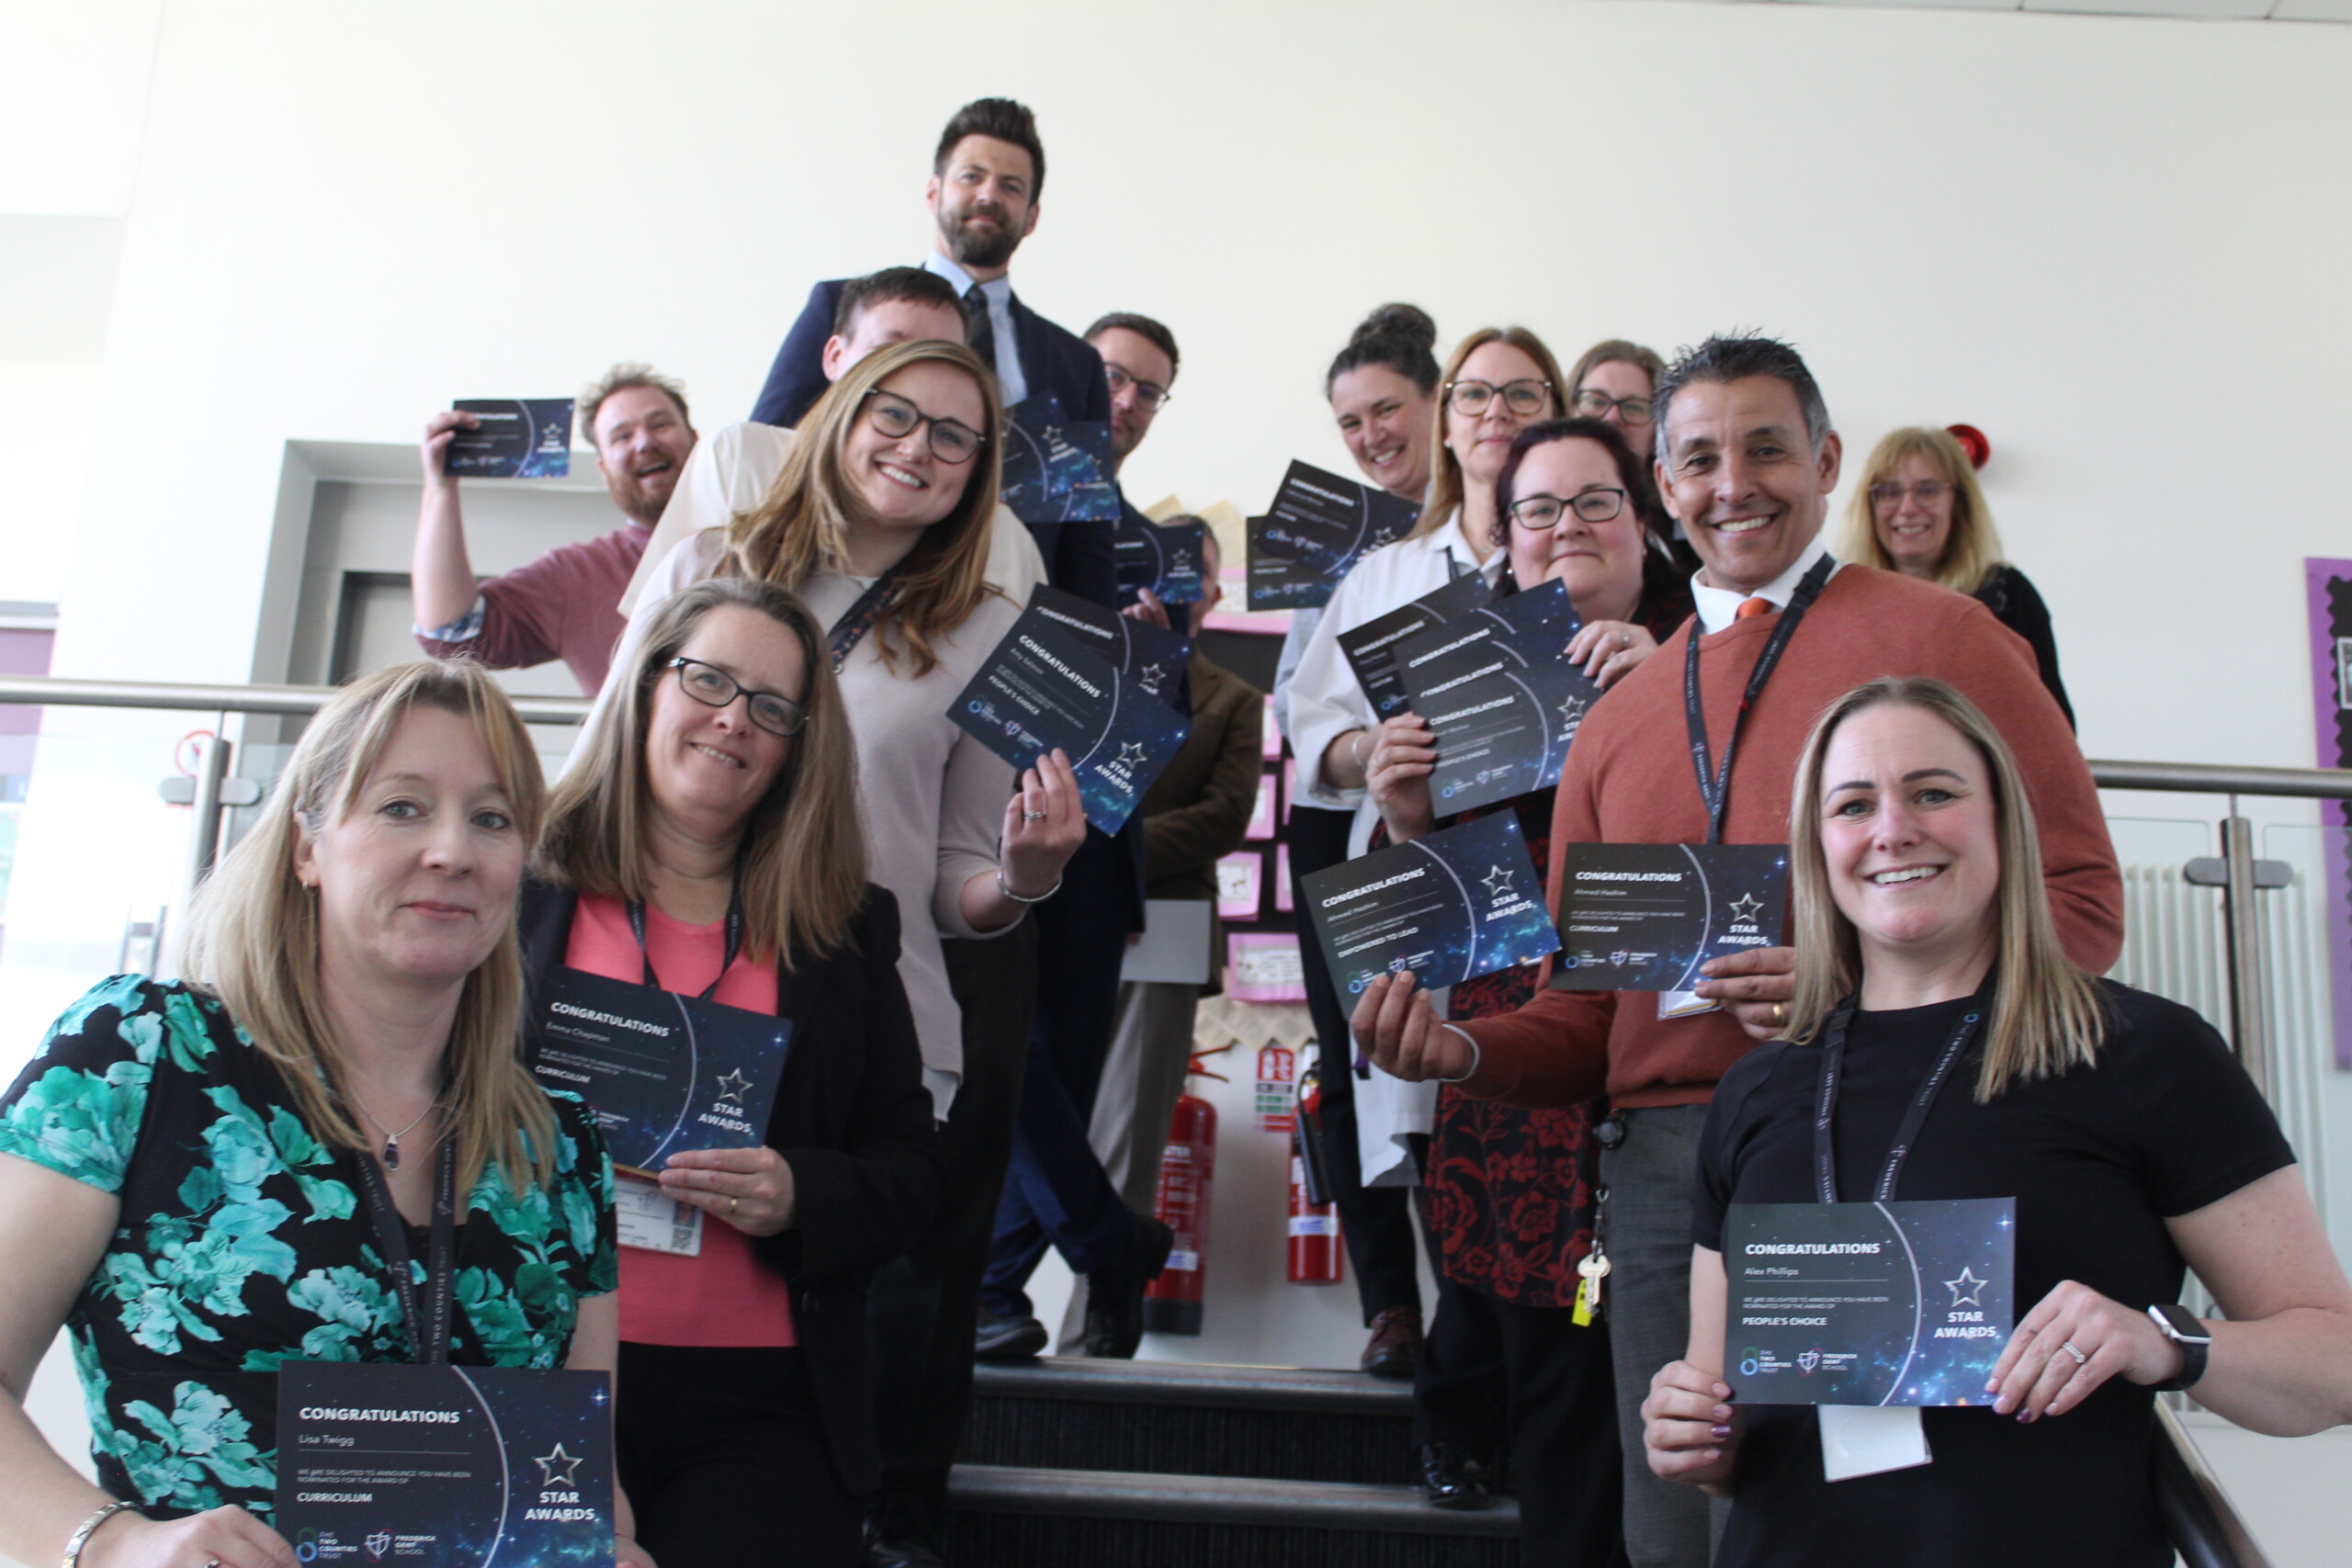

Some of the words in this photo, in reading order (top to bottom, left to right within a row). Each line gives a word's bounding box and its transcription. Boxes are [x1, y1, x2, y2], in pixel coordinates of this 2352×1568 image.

[1019, 635, 1102, 698] CONGRATULATIONS
[1108, 761, 1132, 780] STAR
[1094, 764, 1134, 794] AWARDS
[1576, 872, 1682, 882] CONGRATULATIONS
[1322, 867, 1425, 908] CONGRATULATIONS
[1491, 892, 1520, 908] STAR
[1486, 899, 1532, 921] AWARDS
[1729, 924, 1758, 933] STAR
[1338, 937, 1386, 958] EMPOWERED
[1385, 932, 1397, 942] TO
[1397, 926, 1419, 938] LEAD
[1717, 935, 1769, 945] AWARDS
[551, 1002, 670, 1037] CONGRATULATIONS
[712, 1102, 743, 1118] STAR
[698, 1113, 752, 1133] AWARDS
[1745, 1243, 1881, 1255] CONGRATULATIONS
[1765, 1267, 1799, 1277] Phillips
[1742, 1317, 1788, 1325] PEOPLE'S
[1789, 1317, 1827, 1325] CHOICE
[1947, 1311, 1984, 1322] STAR
[1933, 1325, 1996, 1338] AWARDS
[300, 1407, 460, 1424] CONGRATULATIONS
[299, 1434, 320, 1444] Lisa
[322, 1434, 356, 1447] Twigg
[296, 1492, 373, 1502] CURRICULUM
[539, 1491, 581, 1504] STAR
[524, 1507, 595, 1521] AWARDS
